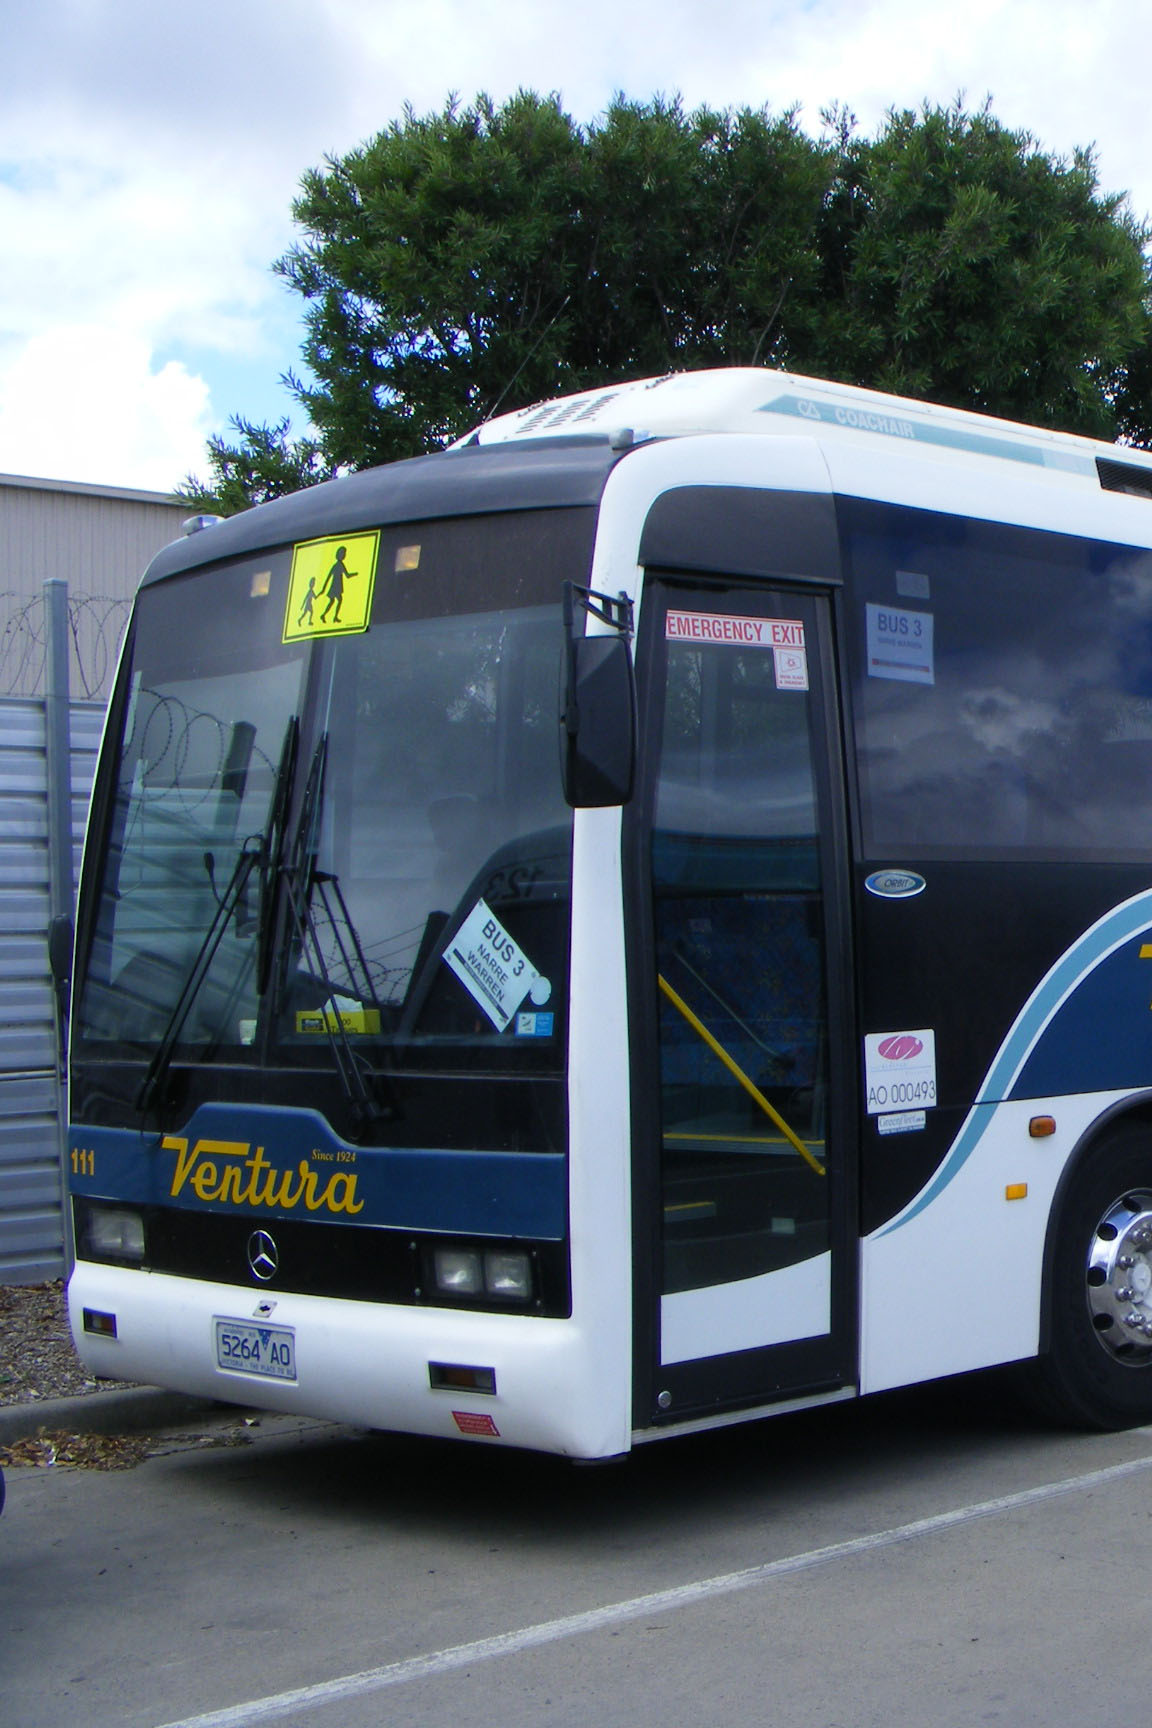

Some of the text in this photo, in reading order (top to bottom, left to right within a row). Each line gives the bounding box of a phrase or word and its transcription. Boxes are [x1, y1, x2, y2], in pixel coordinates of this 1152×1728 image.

[835, 407, 915, 438] COACHAIR
[666, 616, 803, 644] EMERGENCY EXIT
[877, 613, 922, 637] BUS 3
[482, 919, 525, 977] BUS 3
[467, 950, 505, 1002] WARREN
[477, 943, 509, 985] NARRE
[868, 1080, 936, 1106] AO 000493
[71, 1148, 95, 1176] 111
[311, 1148, 356, 1163] Since 1924
[161, 1136, 364, 1214] Ventura
[222, 1334, 290, 1366] 5264 AO
